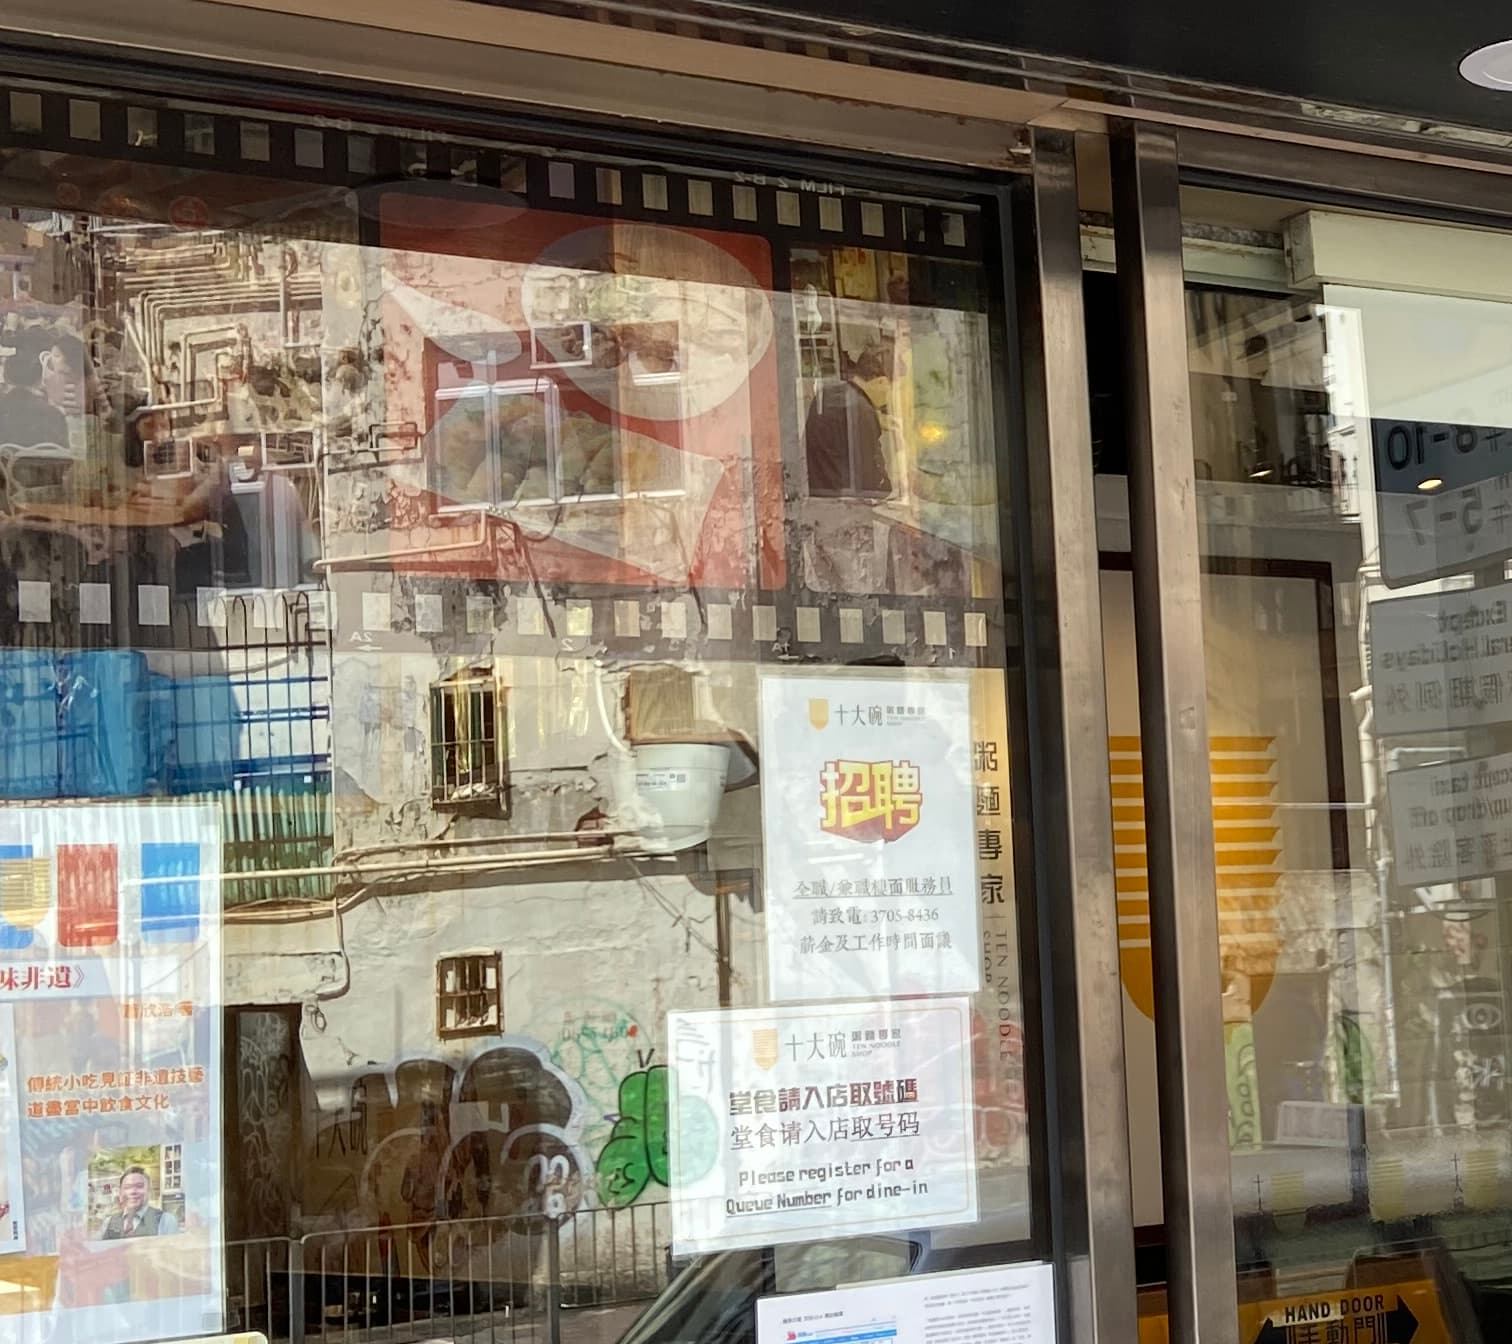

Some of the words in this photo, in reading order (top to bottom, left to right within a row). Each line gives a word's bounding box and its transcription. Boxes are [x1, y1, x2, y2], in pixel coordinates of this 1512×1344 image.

[834, 704, 883, 726] 十大碗
[820, 759, 923, 830] 招聘
[871, 907, 940, 923] 3705-8436
[784, 1032, 847, 1062] 十大碗
[729, 1078, 919, 1116] 堂食請入店取號碼
[730, 1111, 920, 1150] 堂食请入店取号码
[739, 1168, 795, 1187] Please
[799, 1161, 871, 1182] register
[876, 1158, 902, 1176] for
[904, 1159, 914, 1170] a
[726, 1197, 773, 1215] Queue
[777, 1189, 832, 1210] Number
[837, 1187, 863, 1206] for
[866, 1180, 929, 1200] dine-in
[1284, 1301, 1332, 1323] HAND
[1340, 1294, 1385, 1317] DOOR
